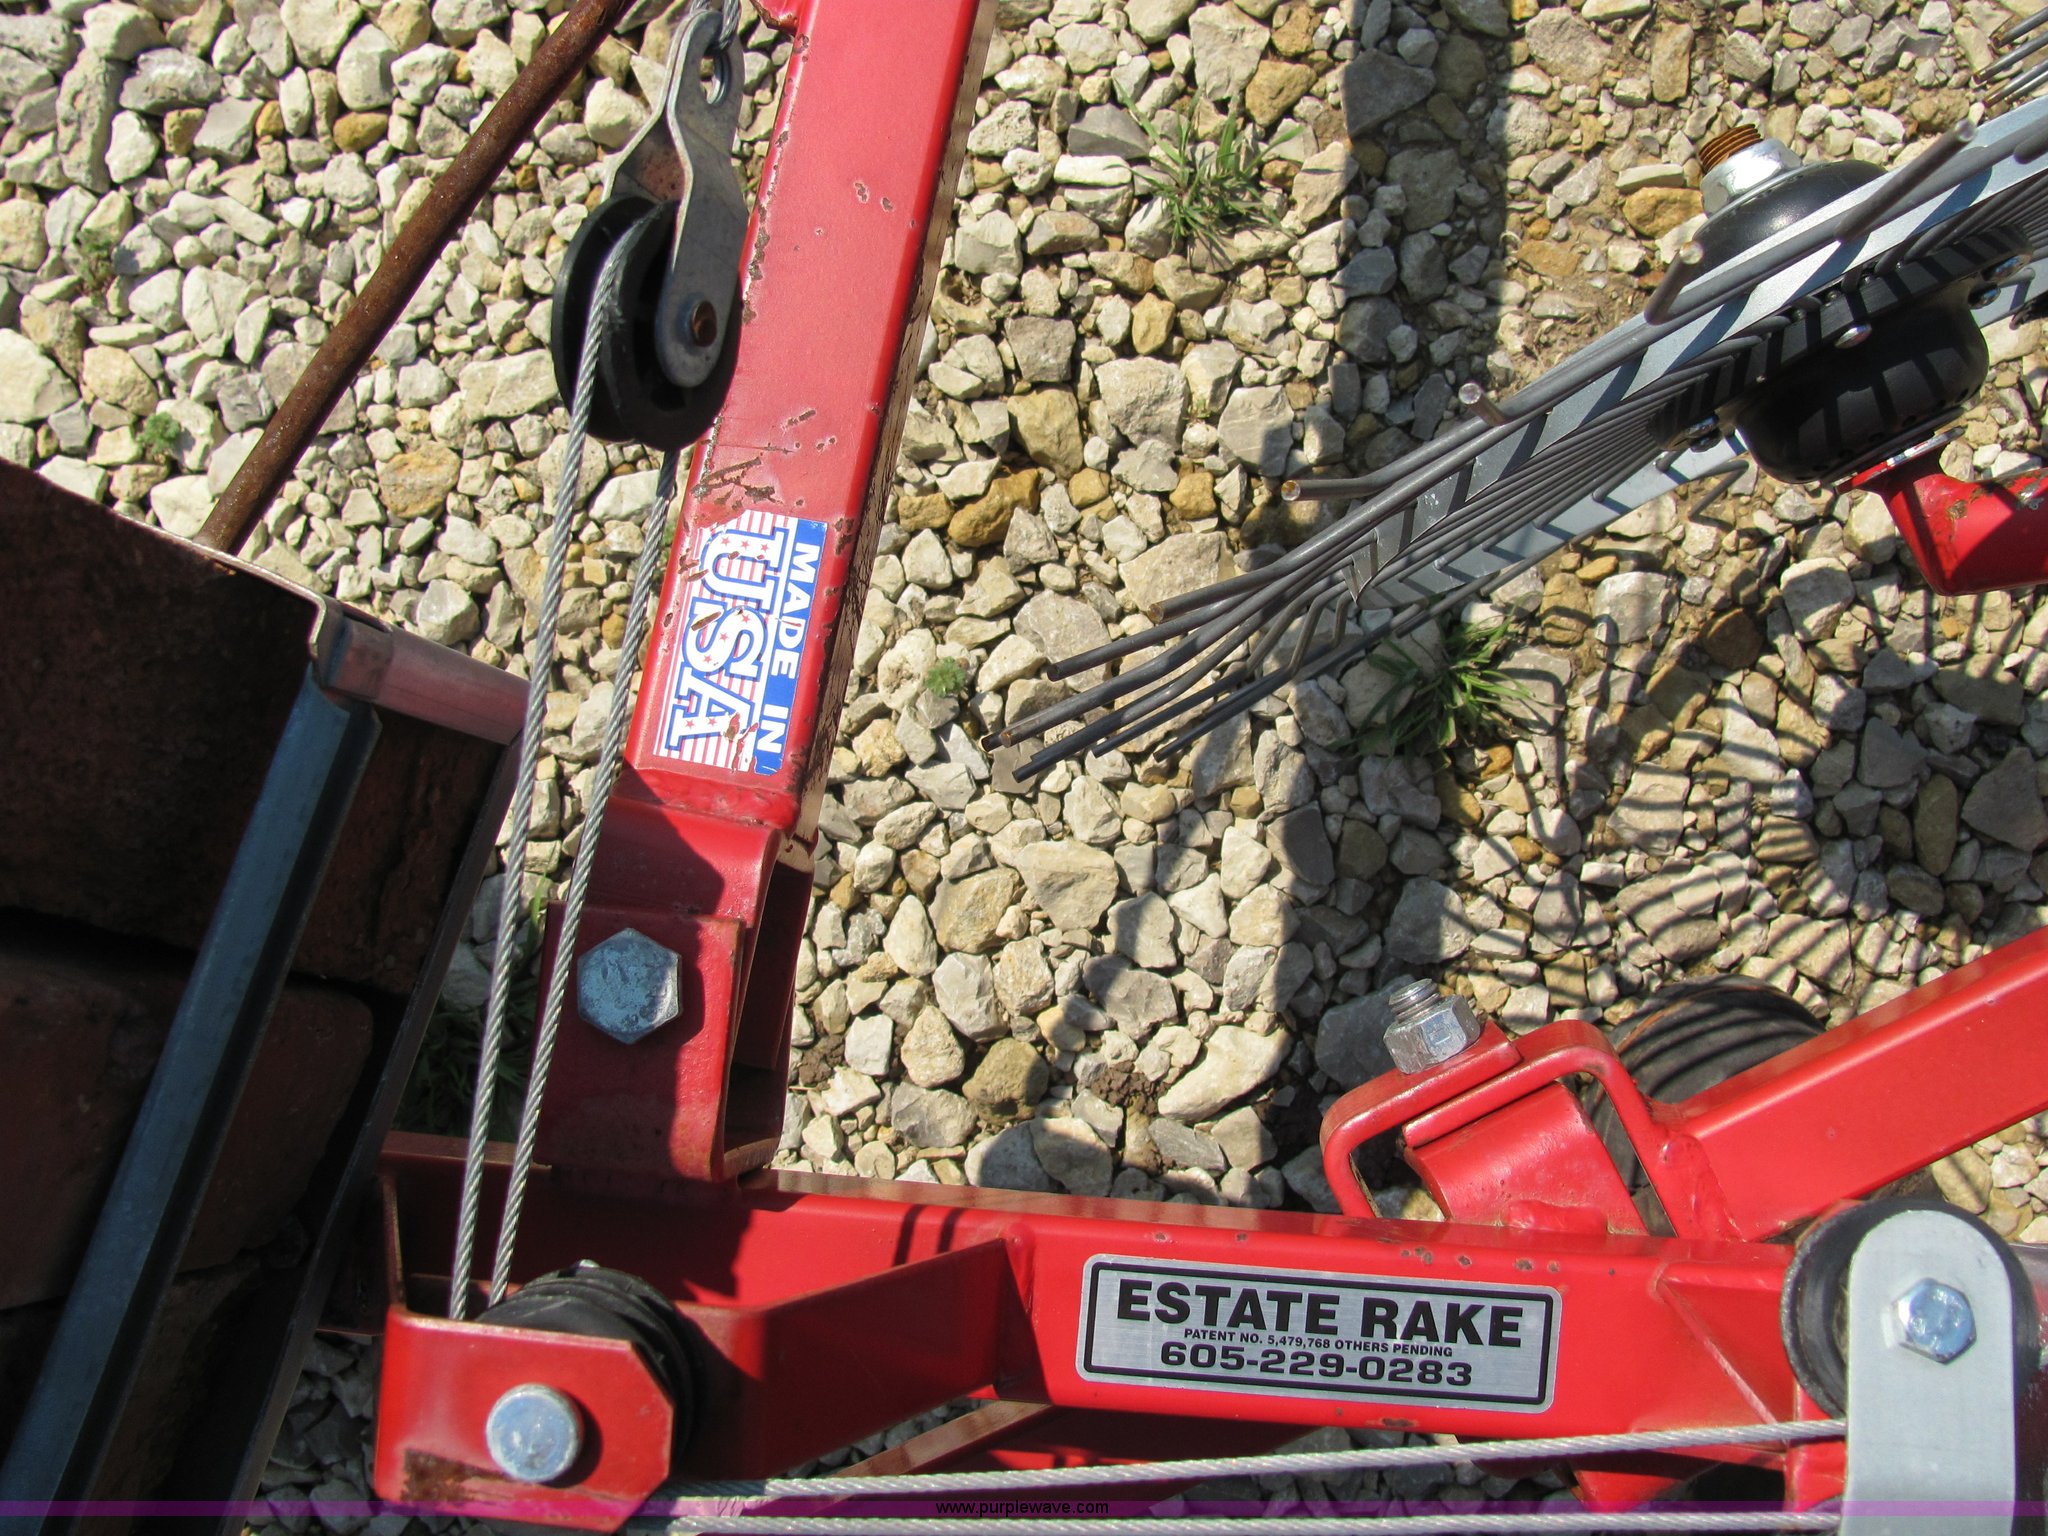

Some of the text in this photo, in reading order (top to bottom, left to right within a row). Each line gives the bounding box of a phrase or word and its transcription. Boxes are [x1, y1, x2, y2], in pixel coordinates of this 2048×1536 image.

[665, 527, 789, 752] USA
[757, 542, 821, 754] MADE IN
[1117, 1278, 1523, 1348] ESTATE RAKE
[1184, 1328, 1453, 1357] PATENT NO. 5,479,768 OTHERS PENDING
[1160, 1341, 1472, 1387] 605-229-0283
